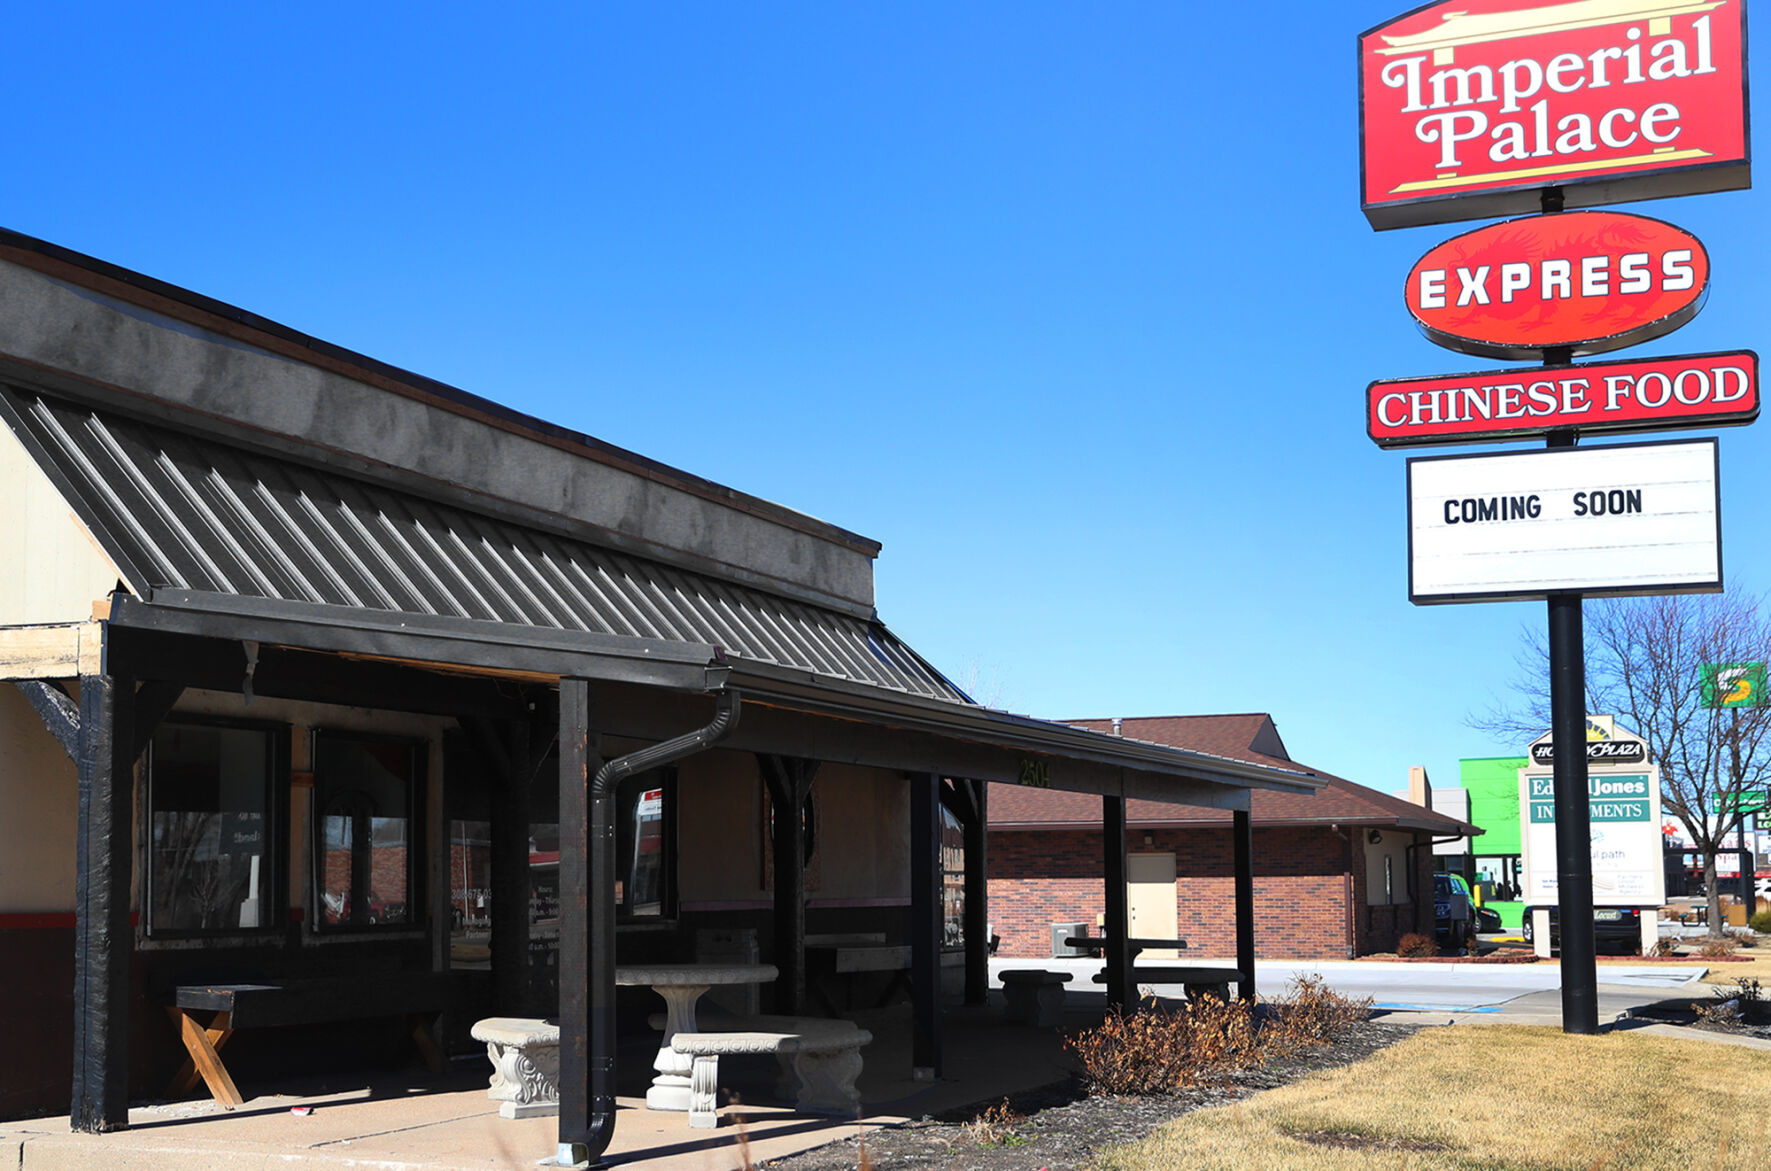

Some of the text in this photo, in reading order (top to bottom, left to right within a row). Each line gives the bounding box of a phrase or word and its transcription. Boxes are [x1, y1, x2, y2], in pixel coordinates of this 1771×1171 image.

[1381, 14, 1716, 113] Imperial
[1415, 98, 1682, 169] Palace
[1419, 249, 1695, 310] EXPRESS
[1376, 366, 1750, 428] CHINESE FOOD
[1443, 489, 1643, 525] COMING SOON
[1591, 743, 1641, 758] PLAZA
[1537, 803, 1642, 819] INMENTS
[1592, 778, 1645, 796] Jones
